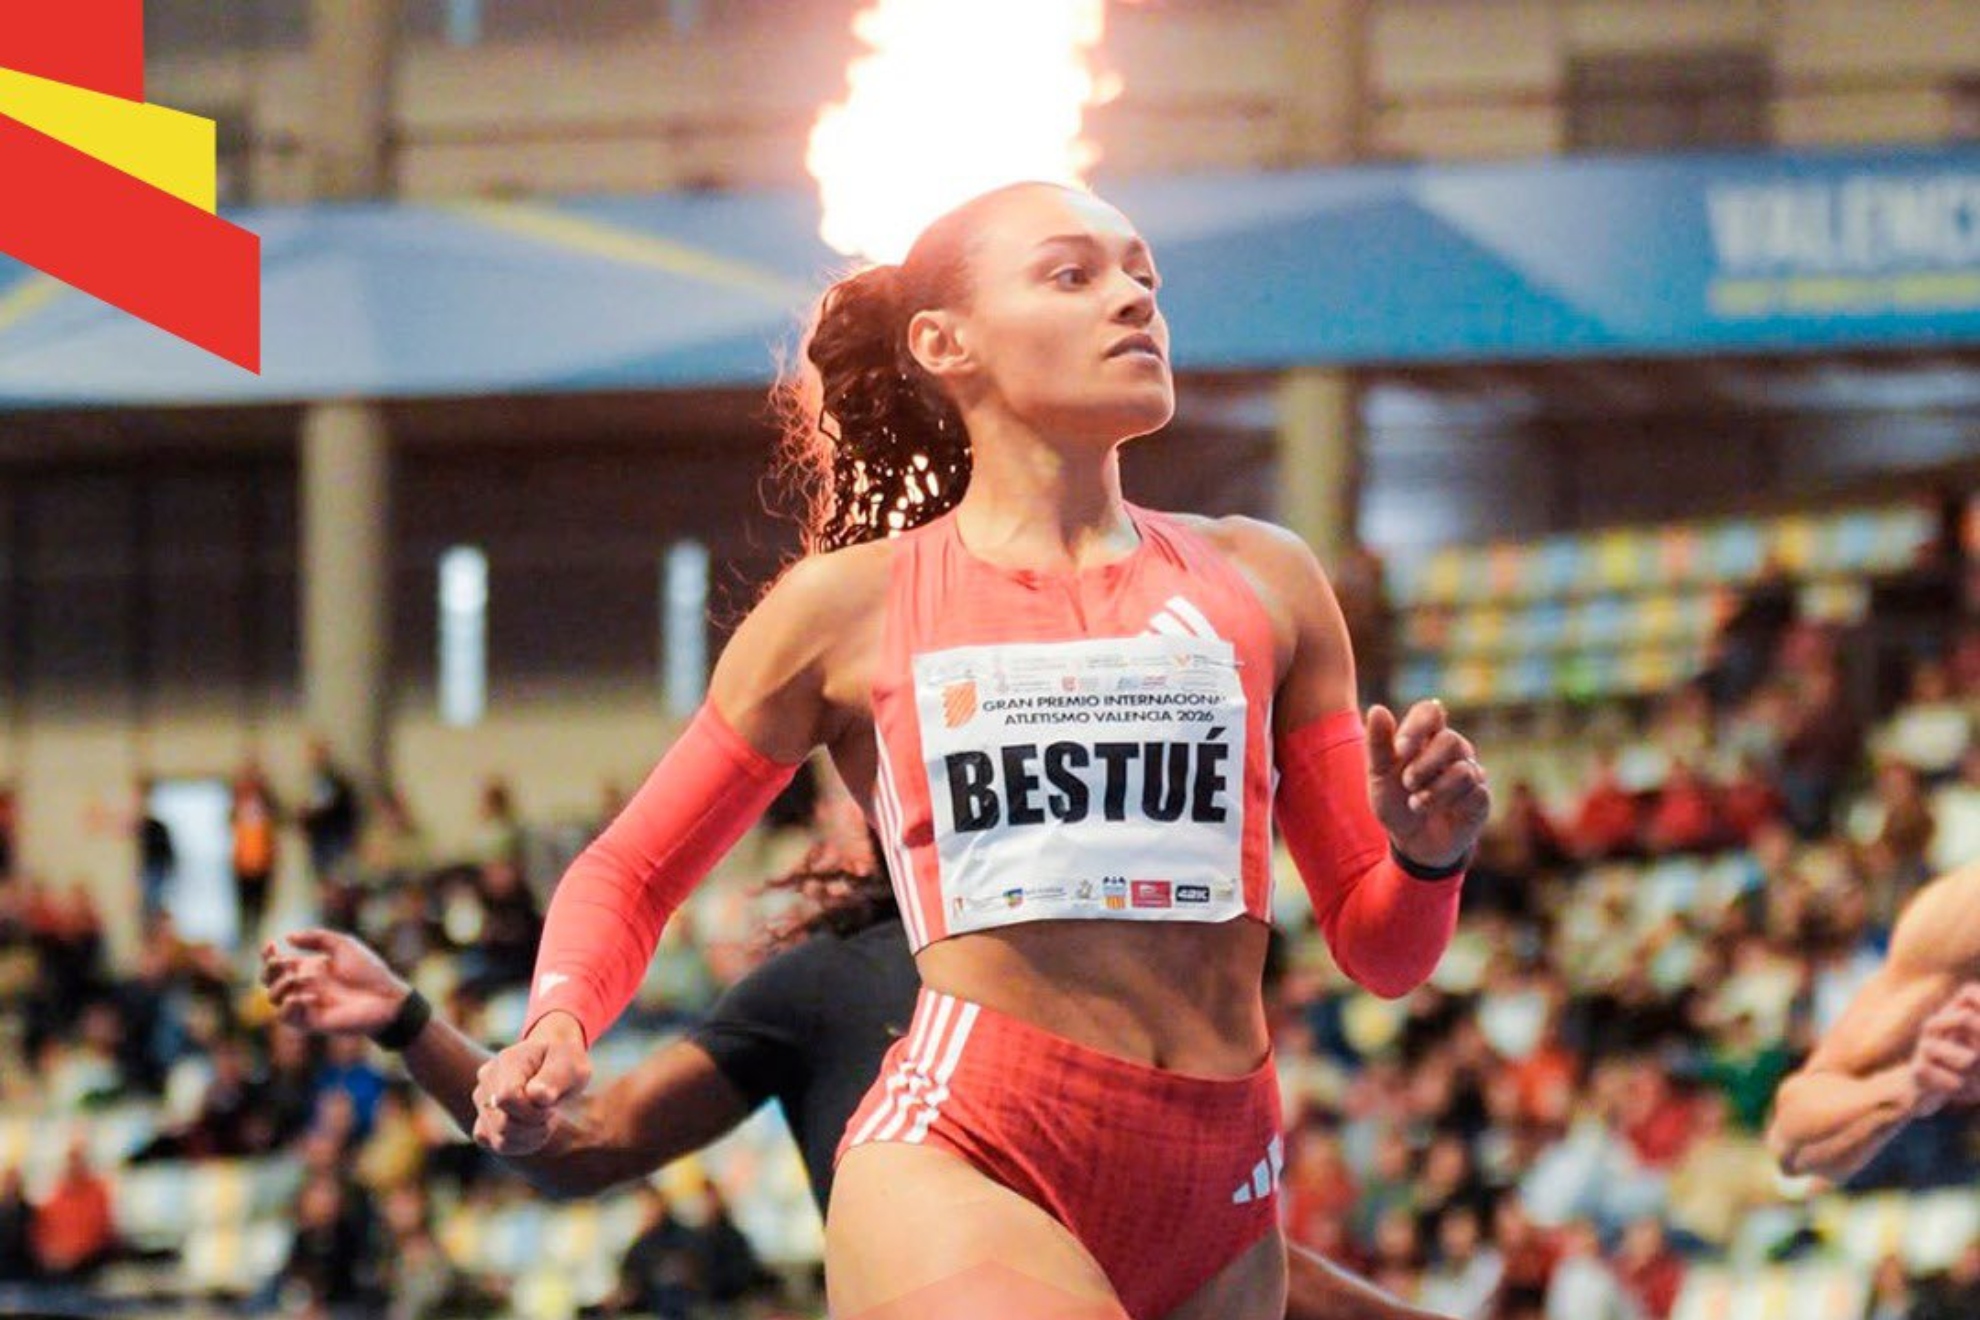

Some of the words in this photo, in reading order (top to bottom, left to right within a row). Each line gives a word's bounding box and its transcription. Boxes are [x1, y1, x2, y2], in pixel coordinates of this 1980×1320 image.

[982, 698, 1032, 712] GRAN
[1037, 694, 1100, 708] PREMIO
[1104, 692, 1226, 706] INTERNACIONA
[1005, 712, 1090, 725] ATLETISMO
[1094, 710, 1172, 722] VALENCIA
[1177, 710, 1214, 722] 2026
[945, 727, 1228, 832] BESTUÉ
